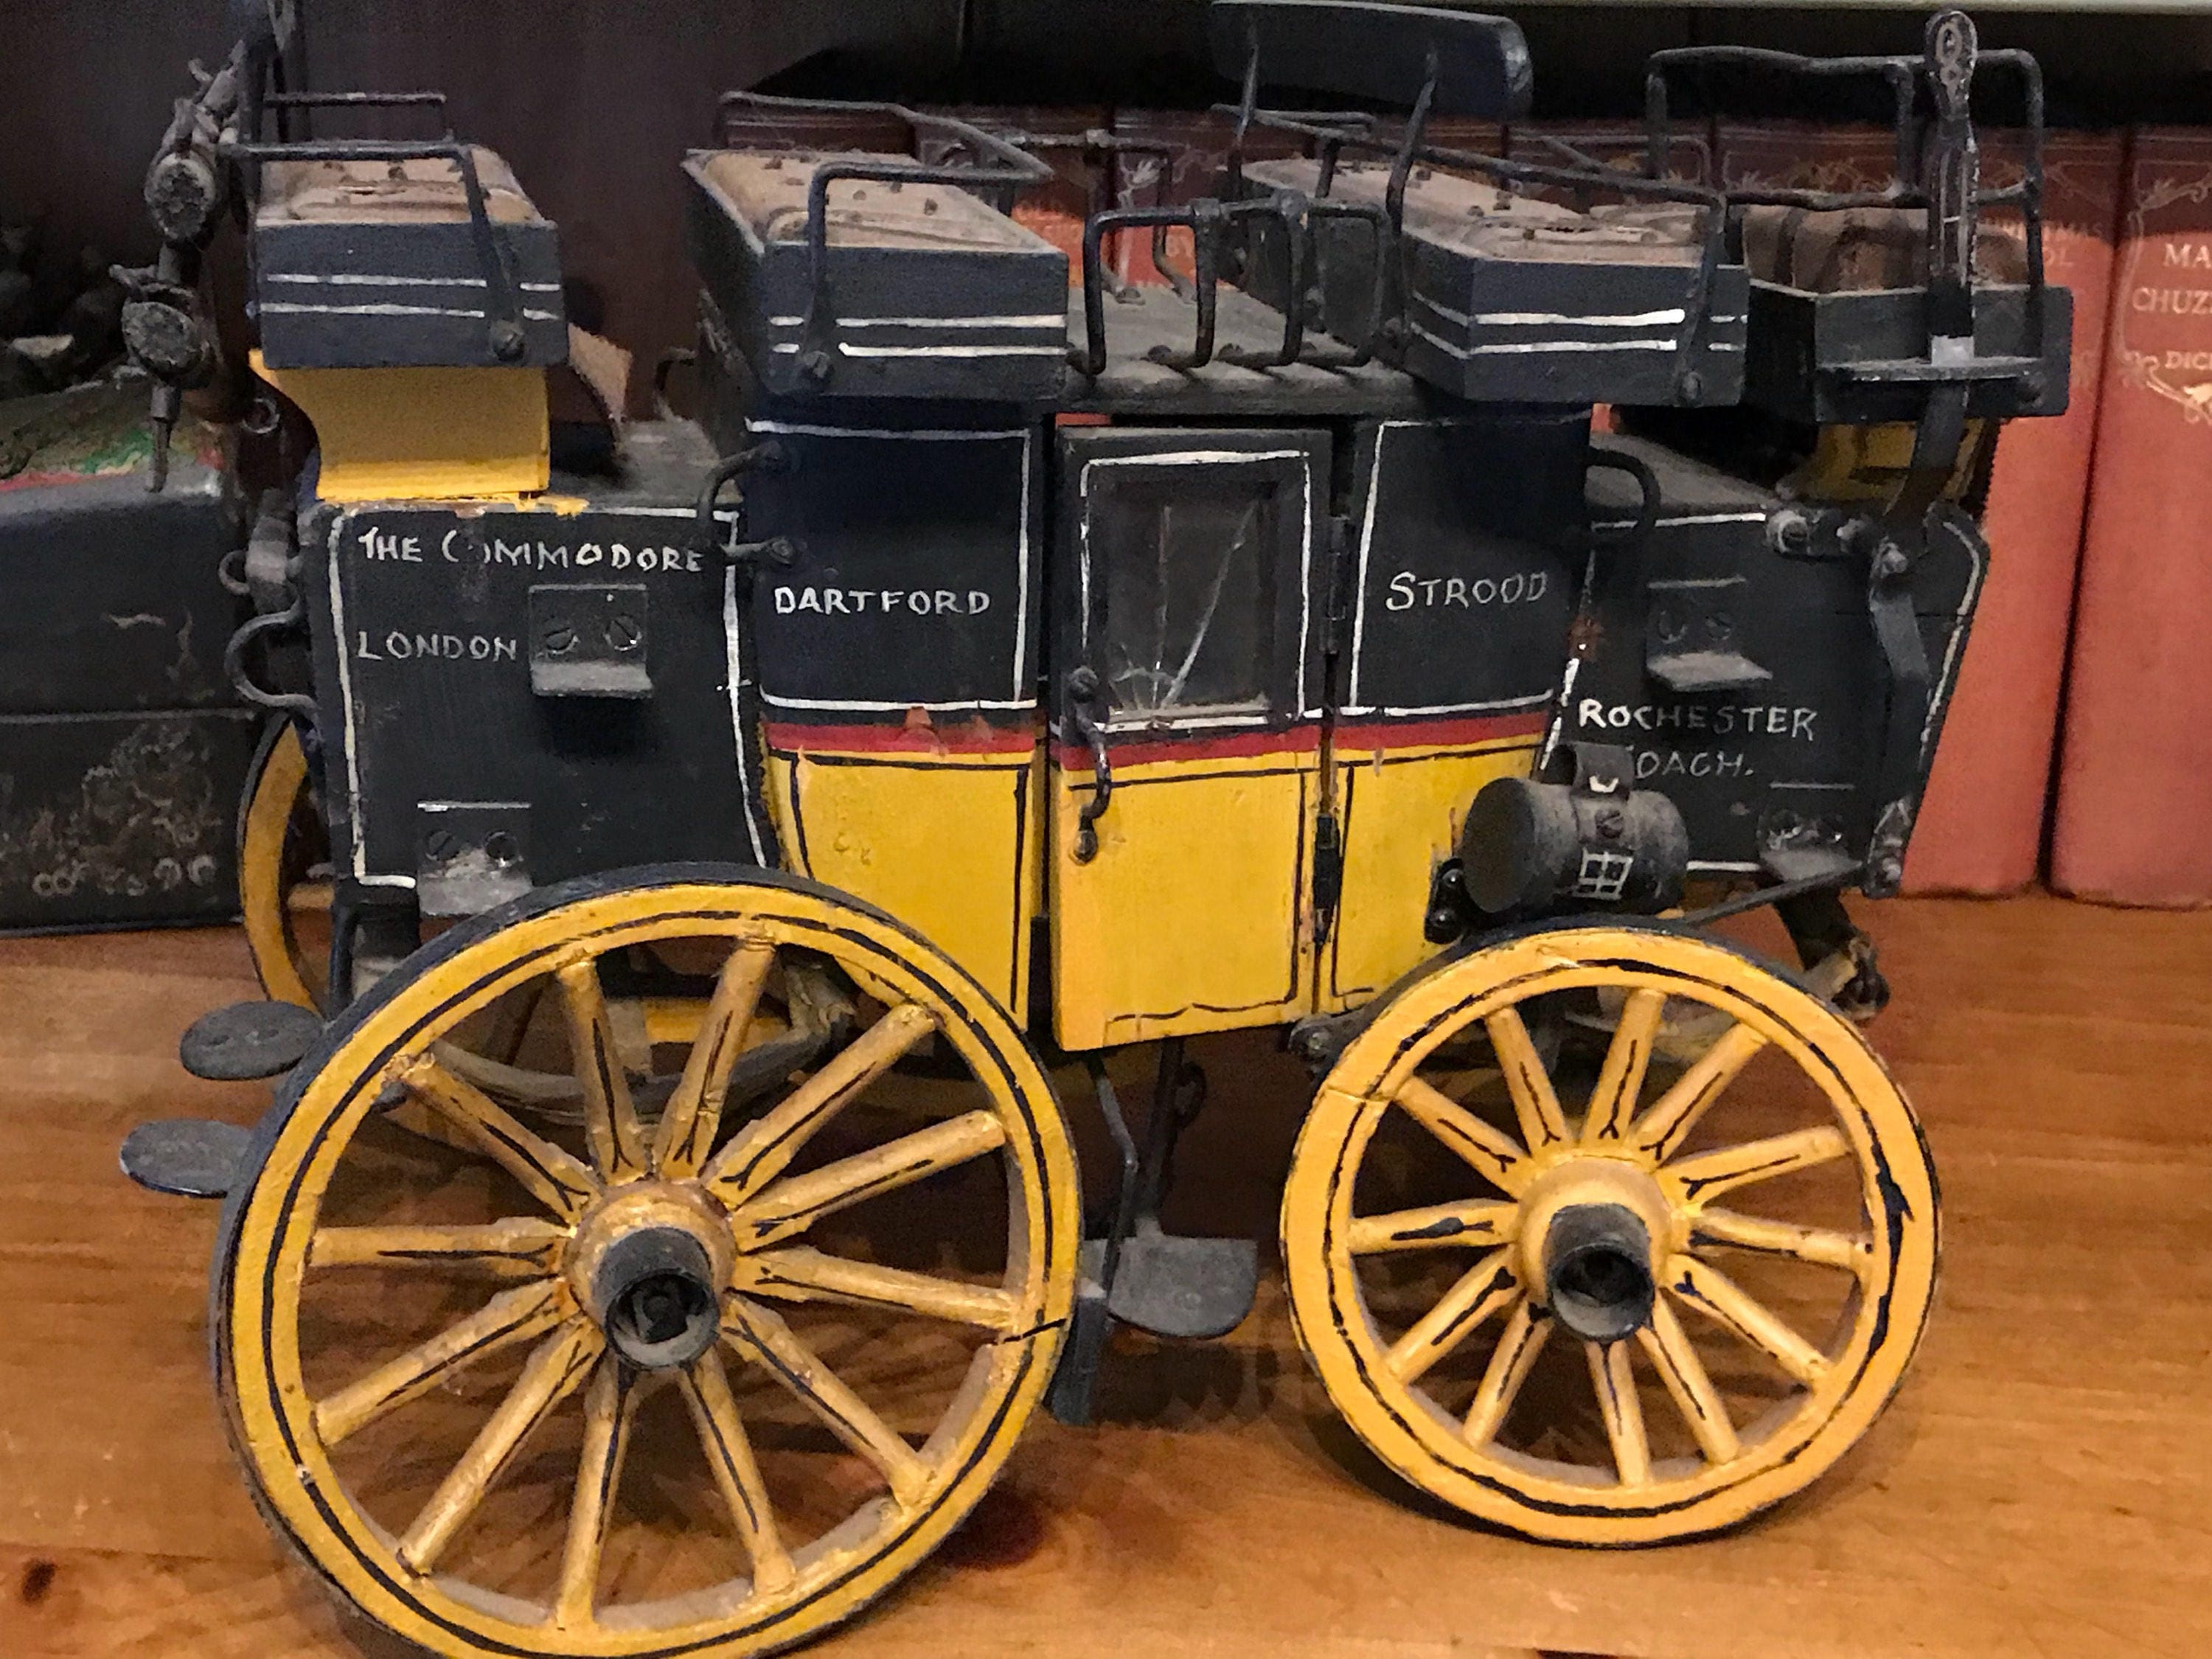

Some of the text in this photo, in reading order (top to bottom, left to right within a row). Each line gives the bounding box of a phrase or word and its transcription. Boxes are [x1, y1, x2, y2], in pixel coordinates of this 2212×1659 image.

[2132, 287, 2212, 315] CHUZ
[2164, 350, 2212, 371] DIC
[358, 526, 423, 563] THE
[773, 586, 991, 615] DARTFORD
[1385, 571, 1548, 611] STROOD
[358, 630, 516, 661] LONDON
[1578, 698, 1818, 742] ROCHESTER
[1624, 744, 1754, 780] OACH.
